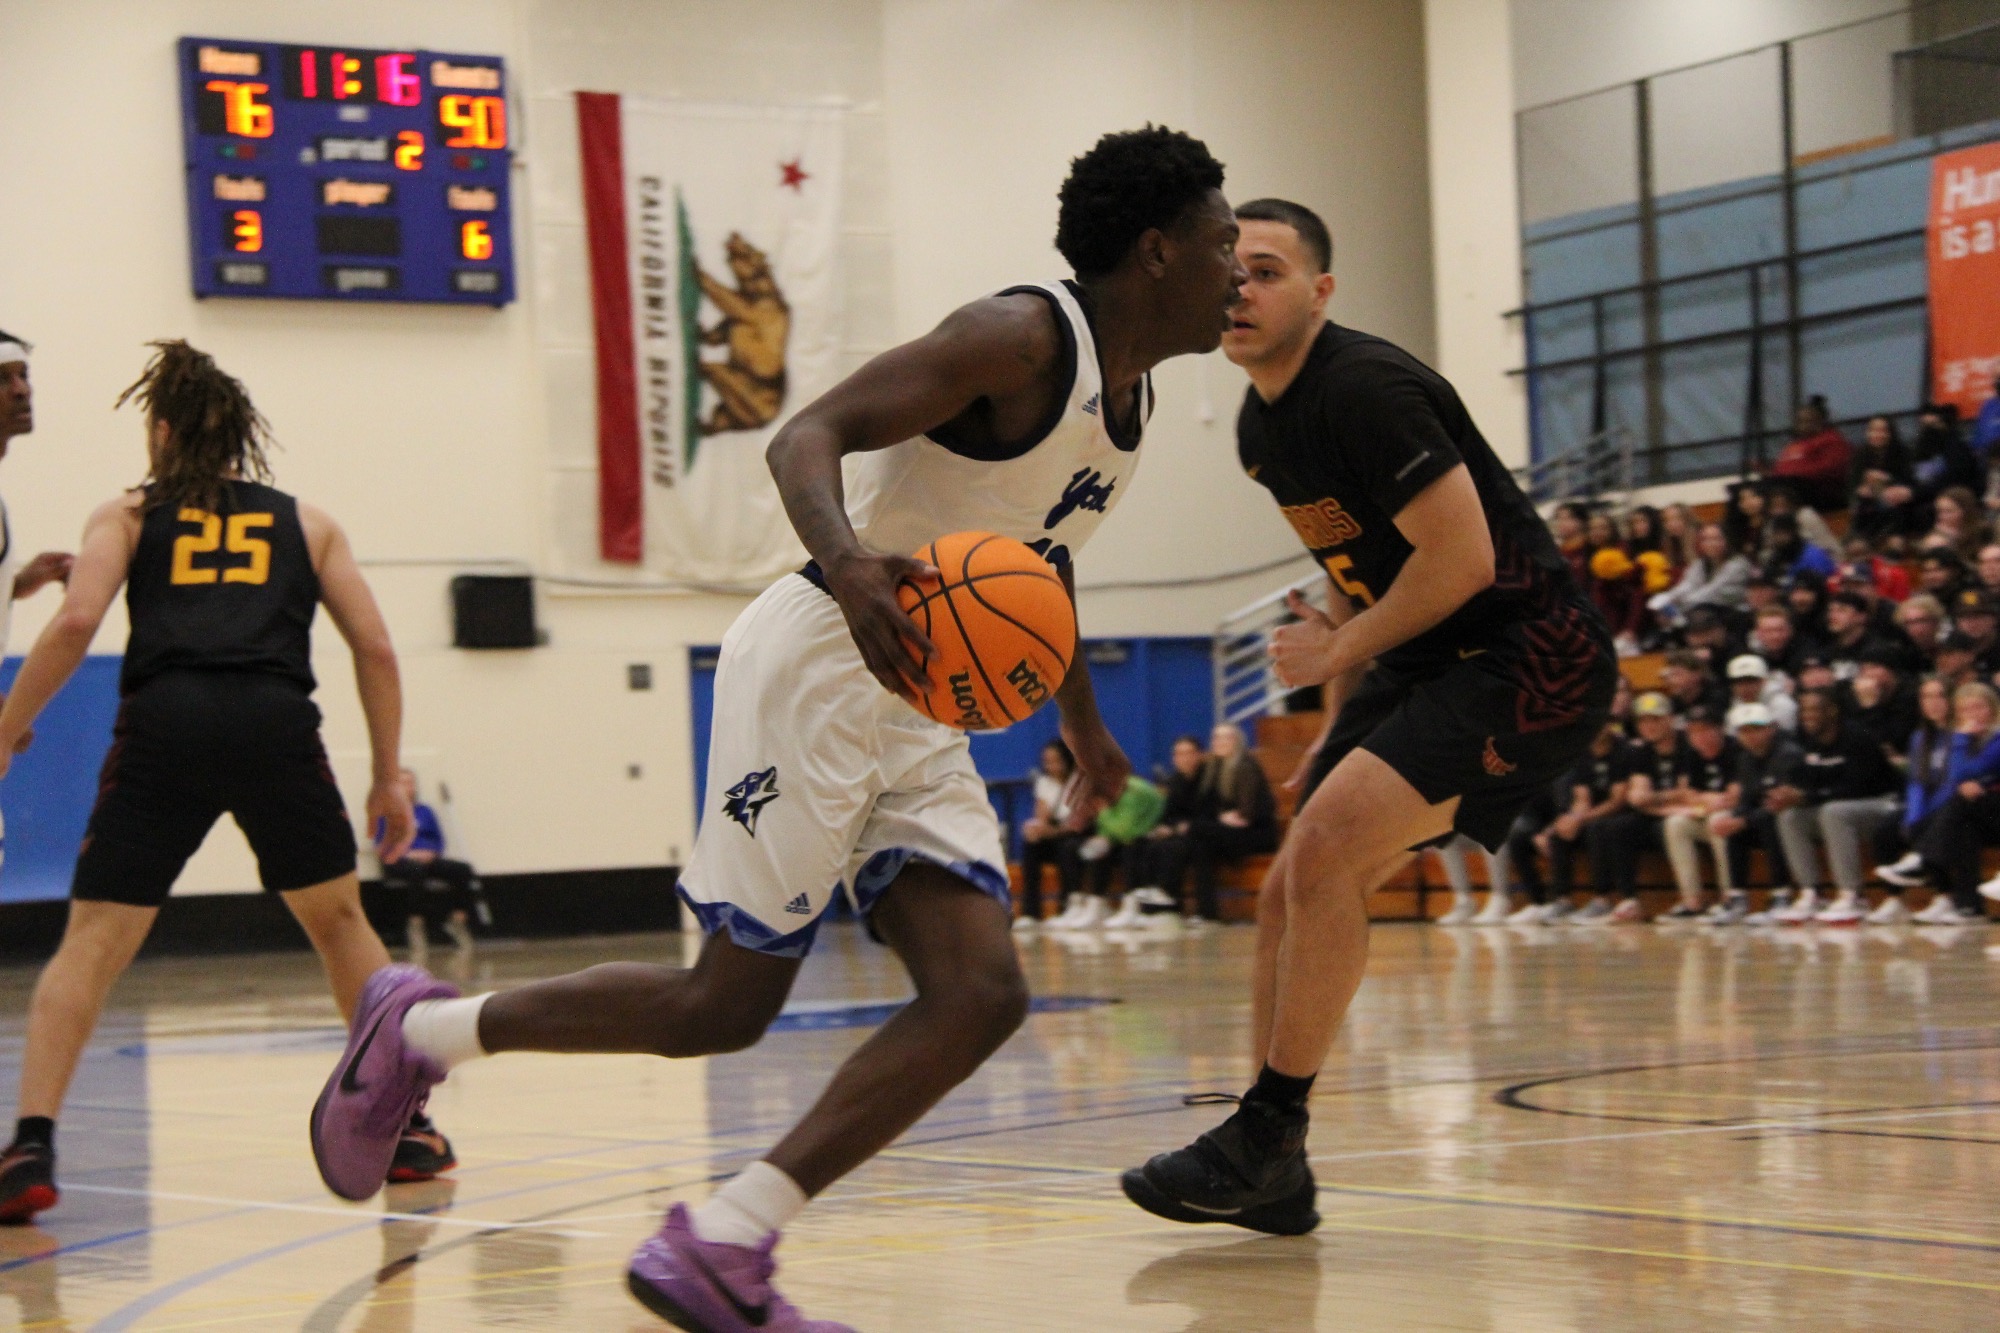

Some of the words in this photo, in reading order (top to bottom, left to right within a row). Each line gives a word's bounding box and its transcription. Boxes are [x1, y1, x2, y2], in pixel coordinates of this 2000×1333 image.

[205, 80, 274, 138] 76
[394, 130, 425, 170] 2
[233, 209, 264, 253] 3
[461, 220, 493, 260] 6
[171, 507, 274, 585] 25
[1006, 658, 1051, 713] CAA
